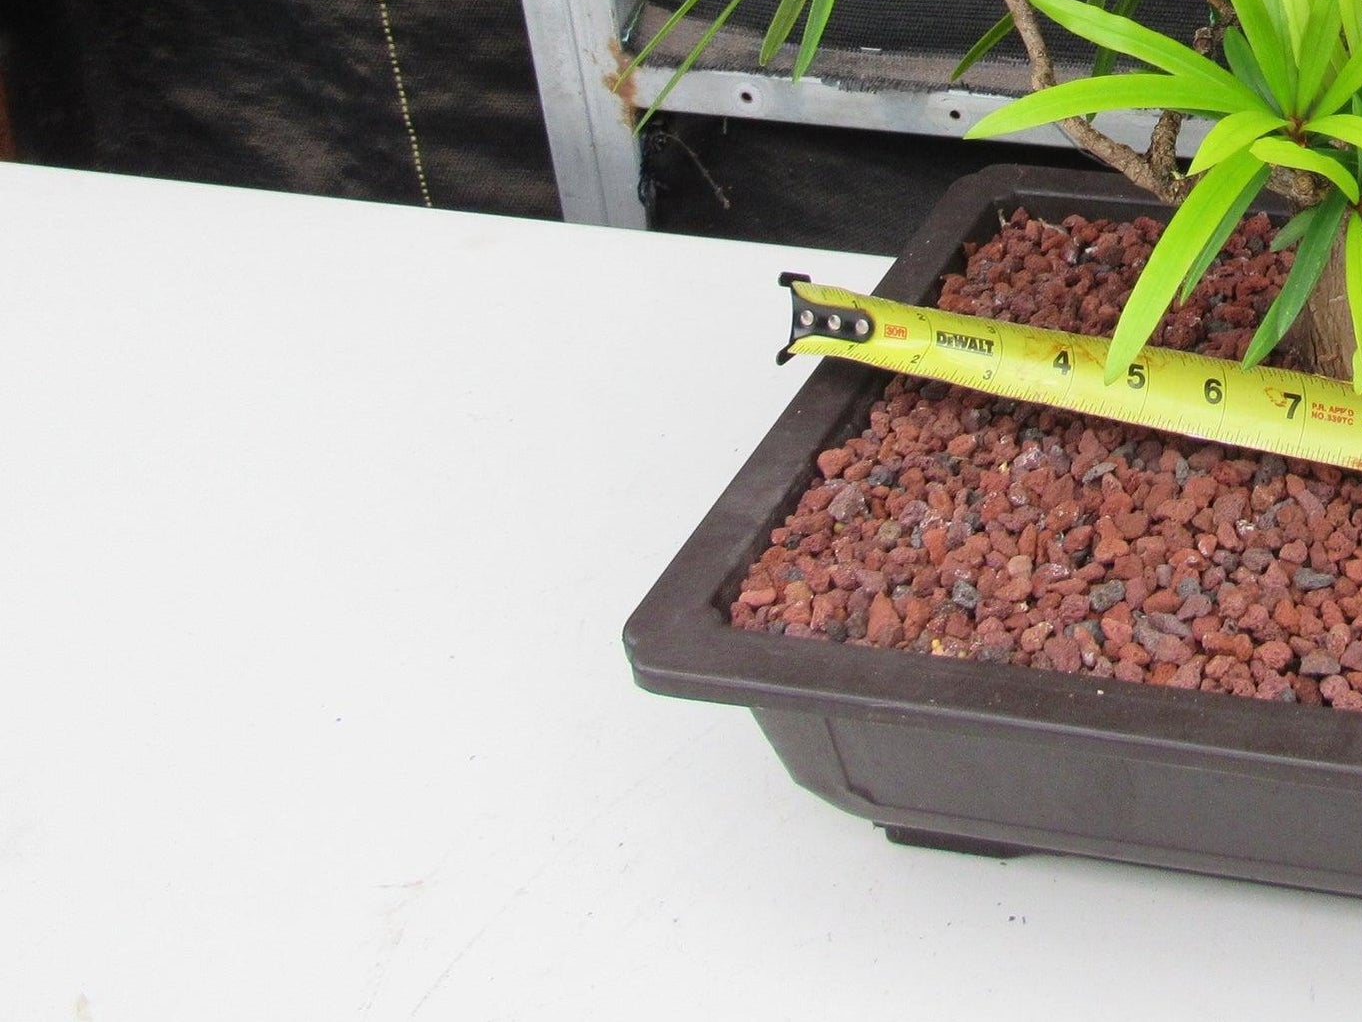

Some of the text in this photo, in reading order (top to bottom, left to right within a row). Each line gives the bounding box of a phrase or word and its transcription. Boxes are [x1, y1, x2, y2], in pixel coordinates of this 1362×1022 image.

[911, 355, 920, 364] 2
[983, 370, 993, 380] 3
[1053, 350, 1071, 376] 4
[1127, 363, 1146, 390] 5
[1204, 378, 1223, 405] 6
[1283, 392, 1302, 420] 7
